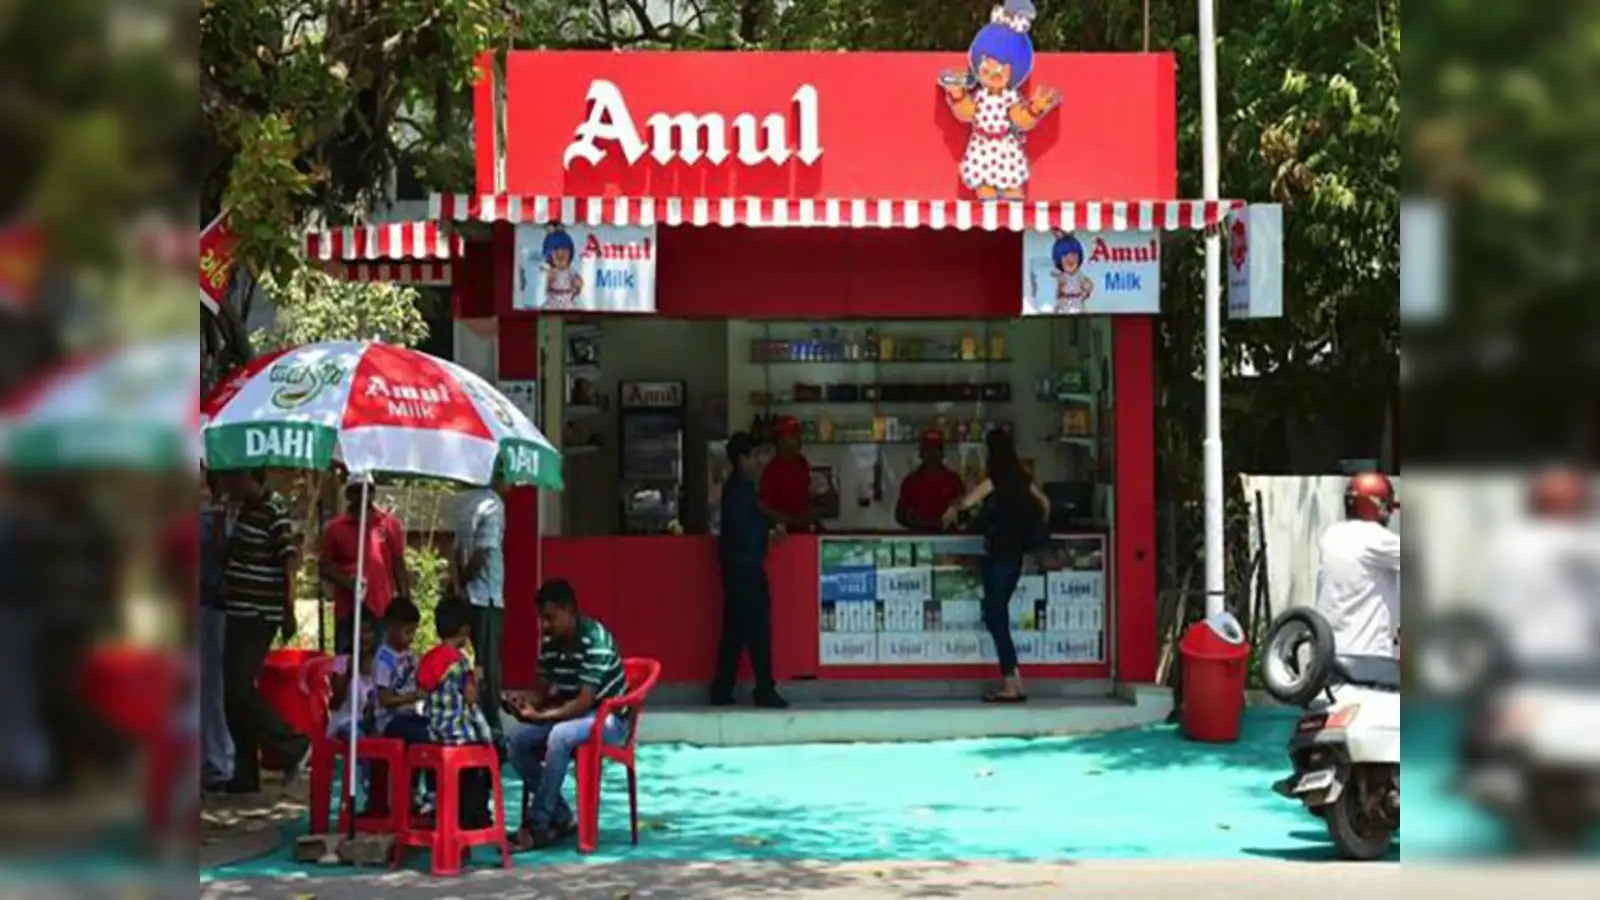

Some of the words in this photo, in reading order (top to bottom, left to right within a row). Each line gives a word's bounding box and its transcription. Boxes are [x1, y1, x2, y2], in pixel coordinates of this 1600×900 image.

[563, 78, 824, 171] Amul
[580, 232, 651, 260] Amul
[1089, 236, 1157, 263] Amul
[595, 268, 635, 290] Milk
[1104, 271, 1142, 292] Milk
[365, 375, 451, 403] Amul
[387, 400, 437, 420] Milk
[245, 426, 314, 460] DAHI
